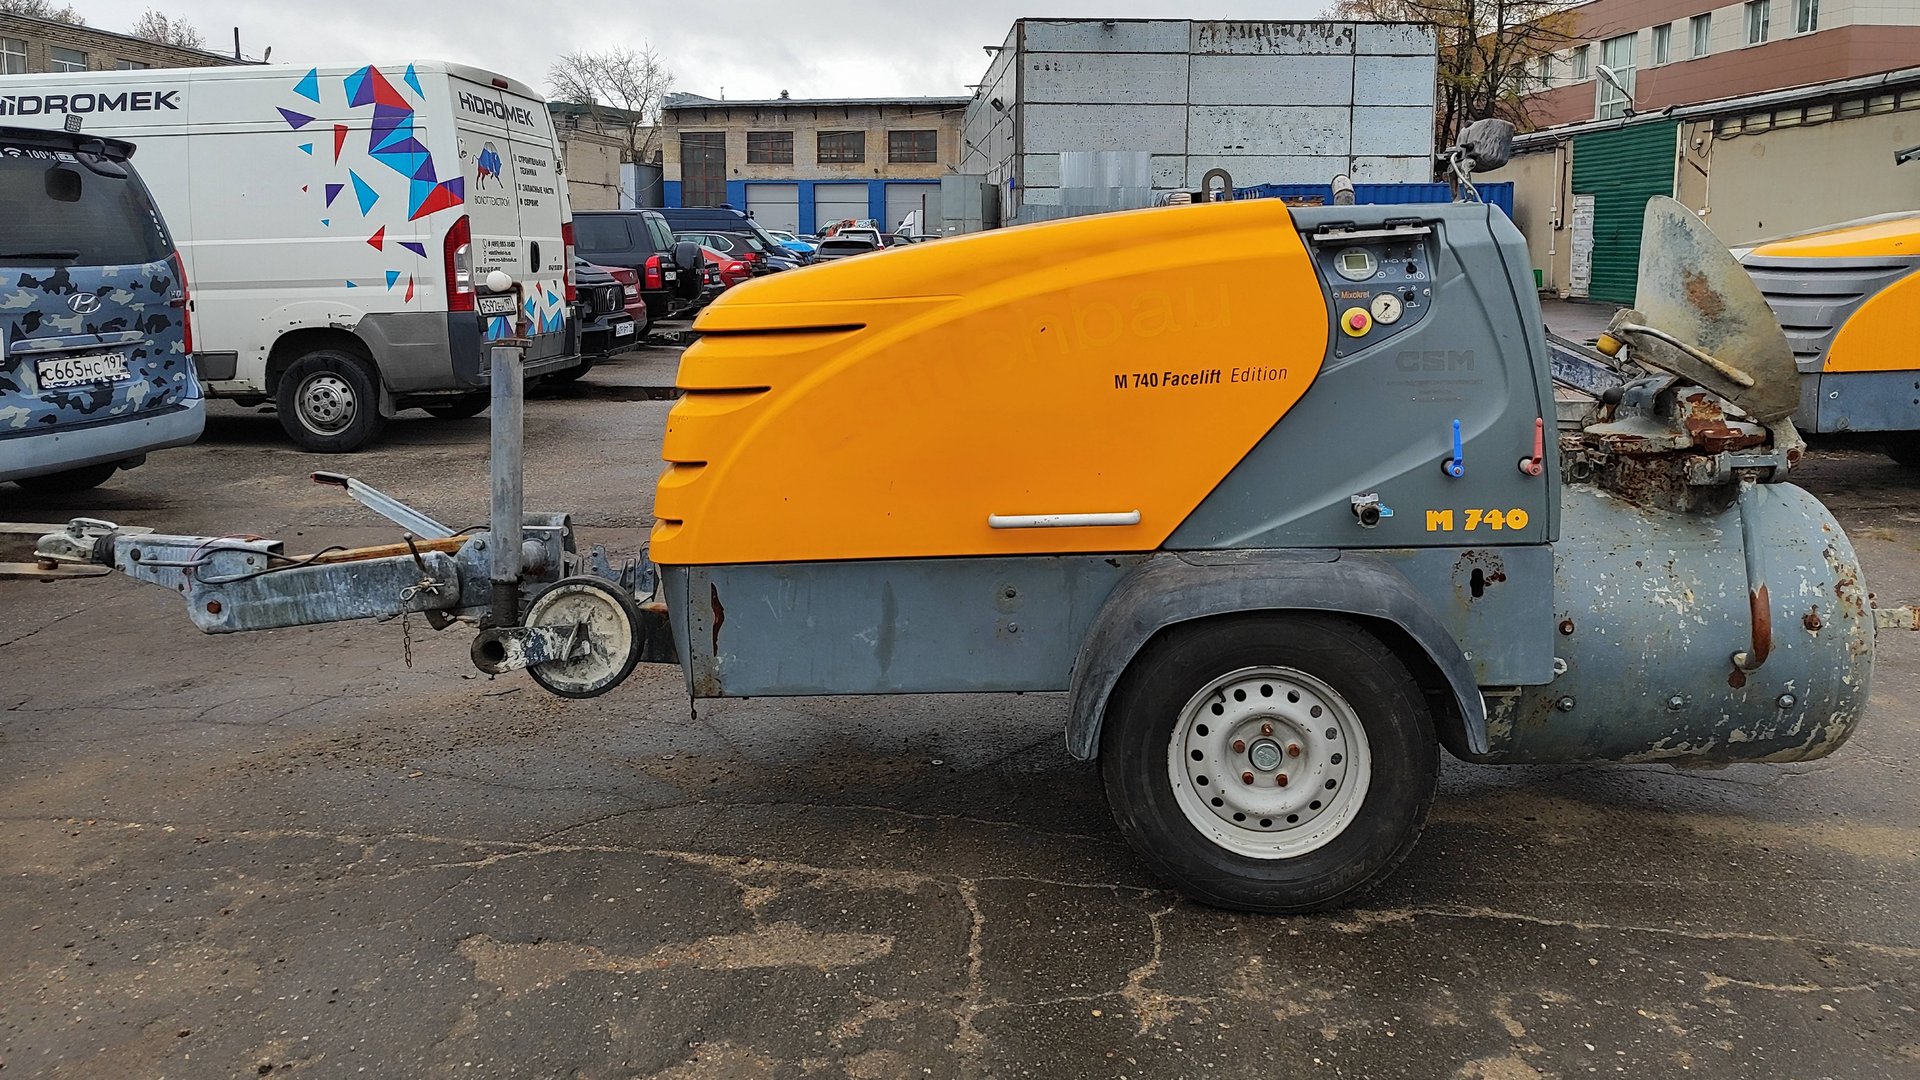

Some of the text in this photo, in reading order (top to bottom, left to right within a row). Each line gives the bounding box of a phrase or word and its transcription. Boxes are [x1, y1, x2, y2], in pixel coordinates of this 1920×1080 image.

[25, 149, 57, 161] 100%
[104, 355, 122, 369] 197
[1114, 366, 1288, 389] M 740 Facelift Edition
[1426, 508, 1529, 532] M 740
